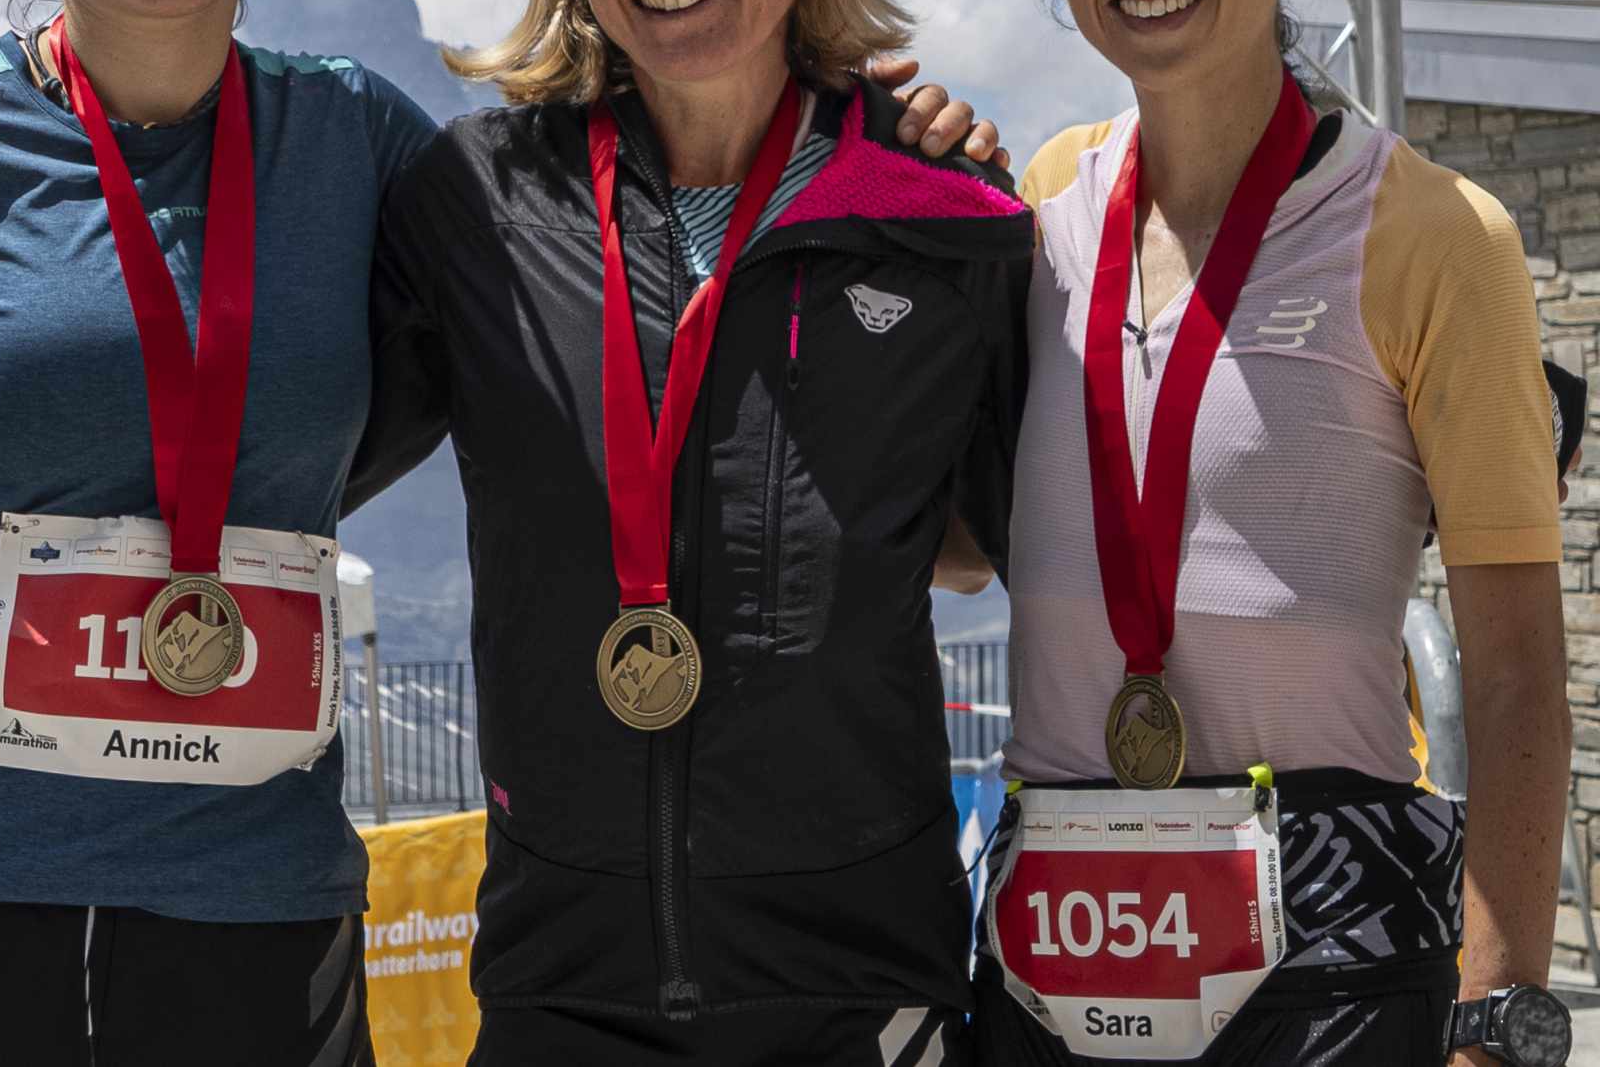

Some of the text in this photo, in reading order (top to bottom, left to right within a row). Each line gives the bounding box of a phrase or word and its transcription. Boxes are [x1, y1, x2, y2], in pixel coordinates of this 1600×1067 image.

[330, 595, 338, 609] Uhr
[311, 632, 322, 688] T-Shirt: XXS
[332, 641, 341, 676] Startzeit:
[327, 703, 337, 728] Annick
[0, 735, 58, 751] marathon
[102, 729, 221, 763] Annick
[1207, 822, 1252, 831] Powerbar
[1268, 848, 1283, 962] mann, Startzeit: 08:30:00 Uhr
[1027, 890, 1199, 958] 1054
[1249, 908, 1260, 944] T-Shirt:
[1084, 1006, 1153, 1037] Sara
